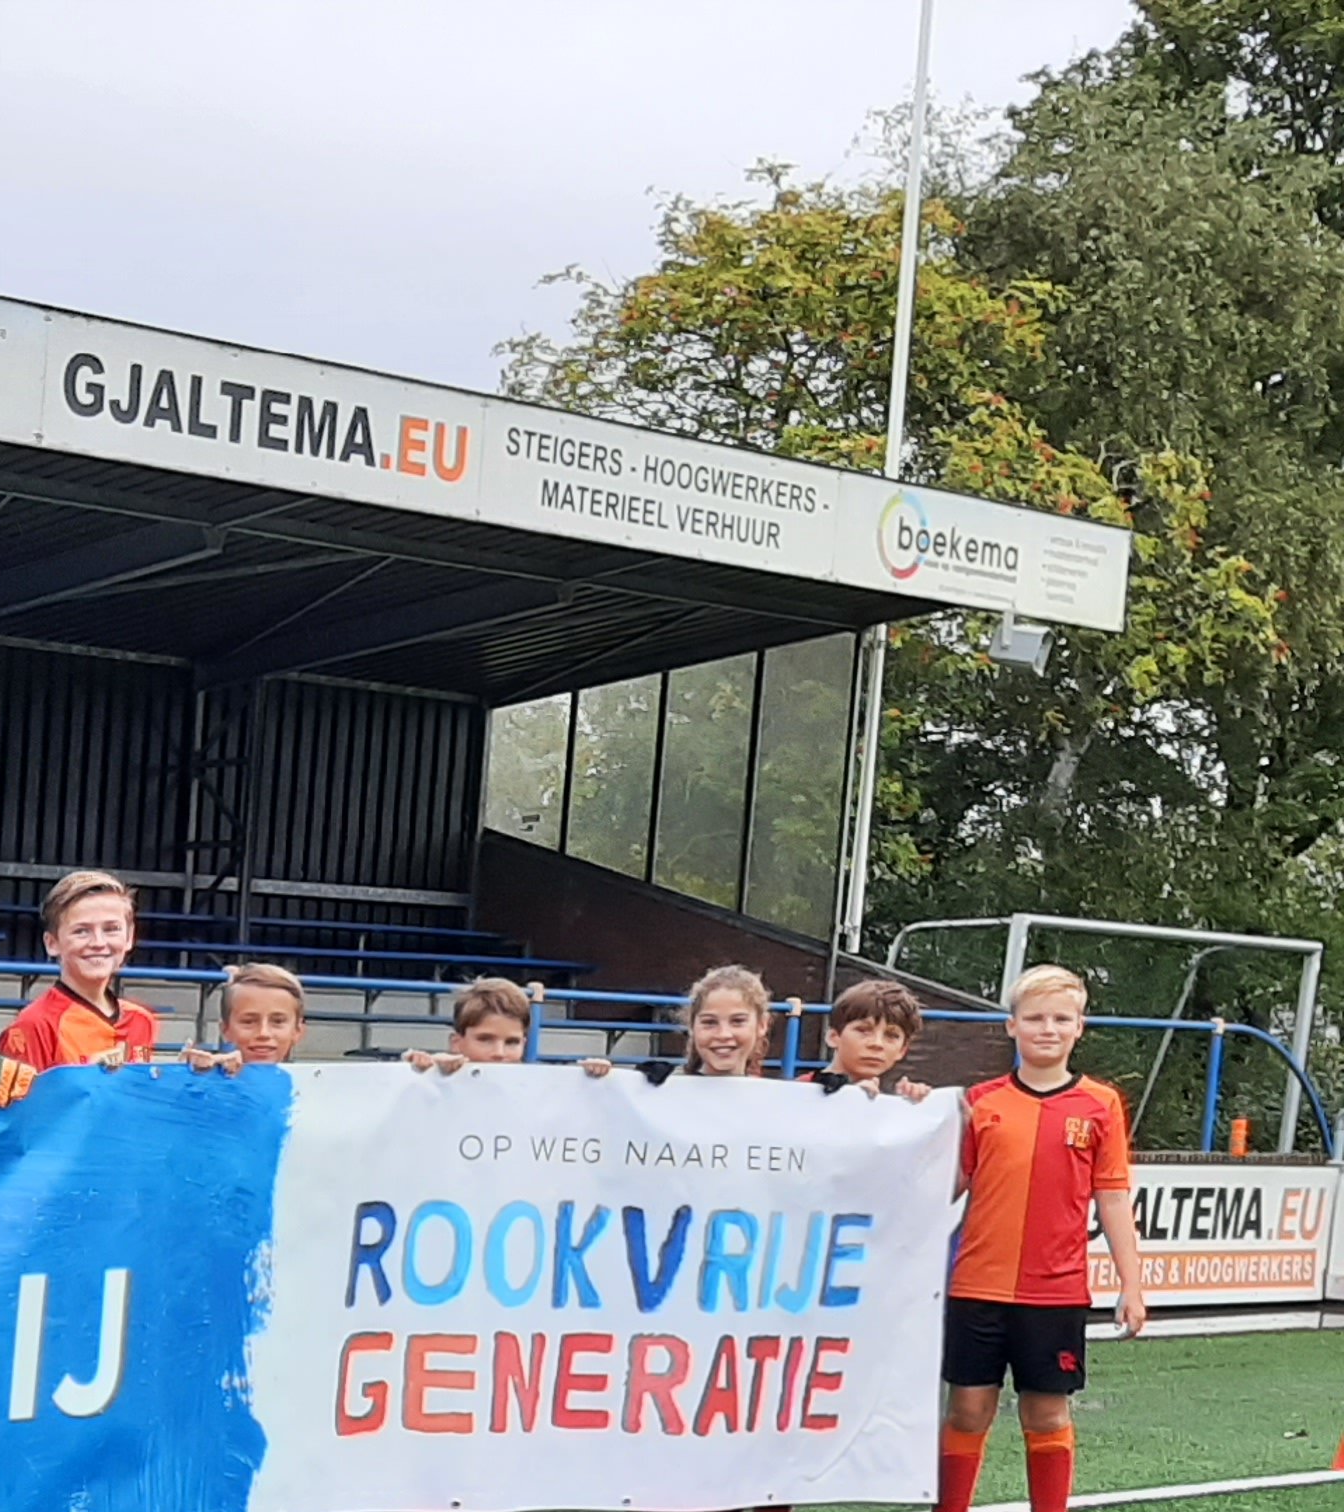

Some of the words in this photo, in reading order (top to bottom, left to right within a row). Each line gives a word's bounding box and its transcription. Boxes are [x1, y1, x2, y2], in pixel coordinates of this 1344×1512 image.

[64, 353, 468, 482] GJALTEMA.EU
[505, 427, 623, 476] STEIGERS
[644, 455, 817, 513] HOOGWERKERS
[541, 479, 668, 530] MATERIEEL
[676, 505, 780, 549] VERHUUR
[898, 517, 1018, 571] boekema
[458, 1134, 512, 1163] OP
[530, 1136, 602, 1164] WEG
[624, 1140, 729, 1170] NAAR
[747, 1145, 807, 1173] EEN
[1088, 1187, 1326, 1241] ALTEMA.EU
[345, 1200, 873, 1313] ROOKVRIJE
[1184, 1254, 1313, 1285] HOOGWERKERS
[334, 1331, 851, 1436] GENERATIE
